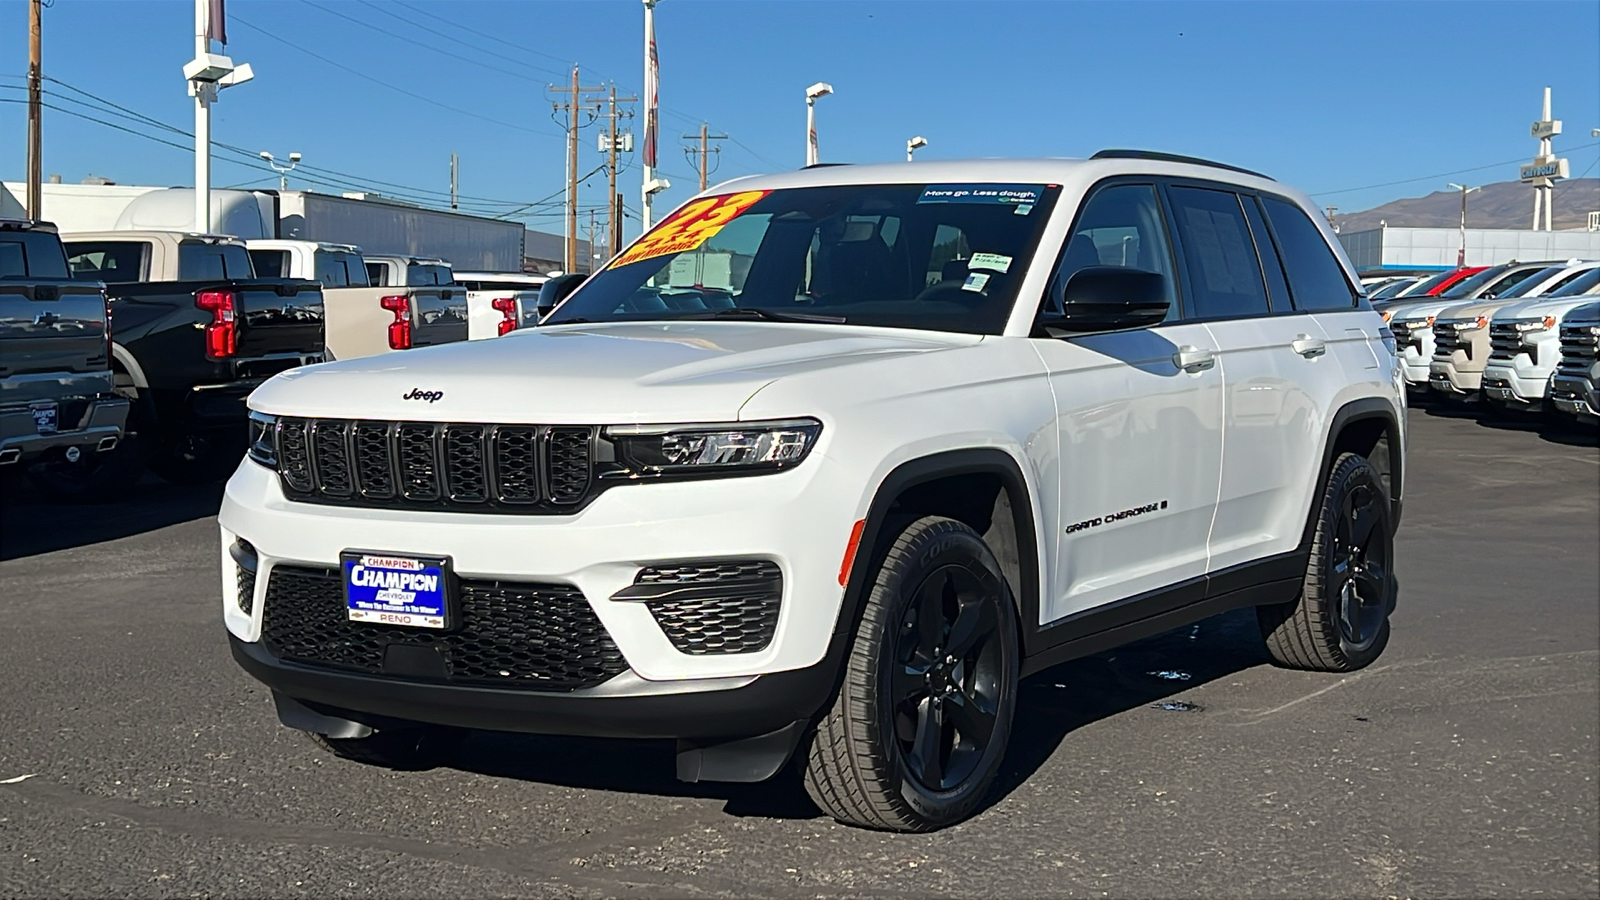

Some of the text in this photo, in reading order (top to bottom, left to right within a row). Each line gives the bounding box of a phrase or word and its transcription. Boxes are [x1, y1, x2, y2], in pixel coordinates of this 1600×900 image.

[999, 190, 1037, 198] dough.
[613, 239, 700, 268] LOW MILEAGE
[403, 387, 444, 404] Jeep
[1065, 502, 1159, 534] GRAND CHEROKEE
[367, 558, 415, 569] CHAMPION
[351, 565, 438, 592] CHAMPION
[378, 592, 413, 600] CHEVROLET
[380, 613, 412, 624] RENO
